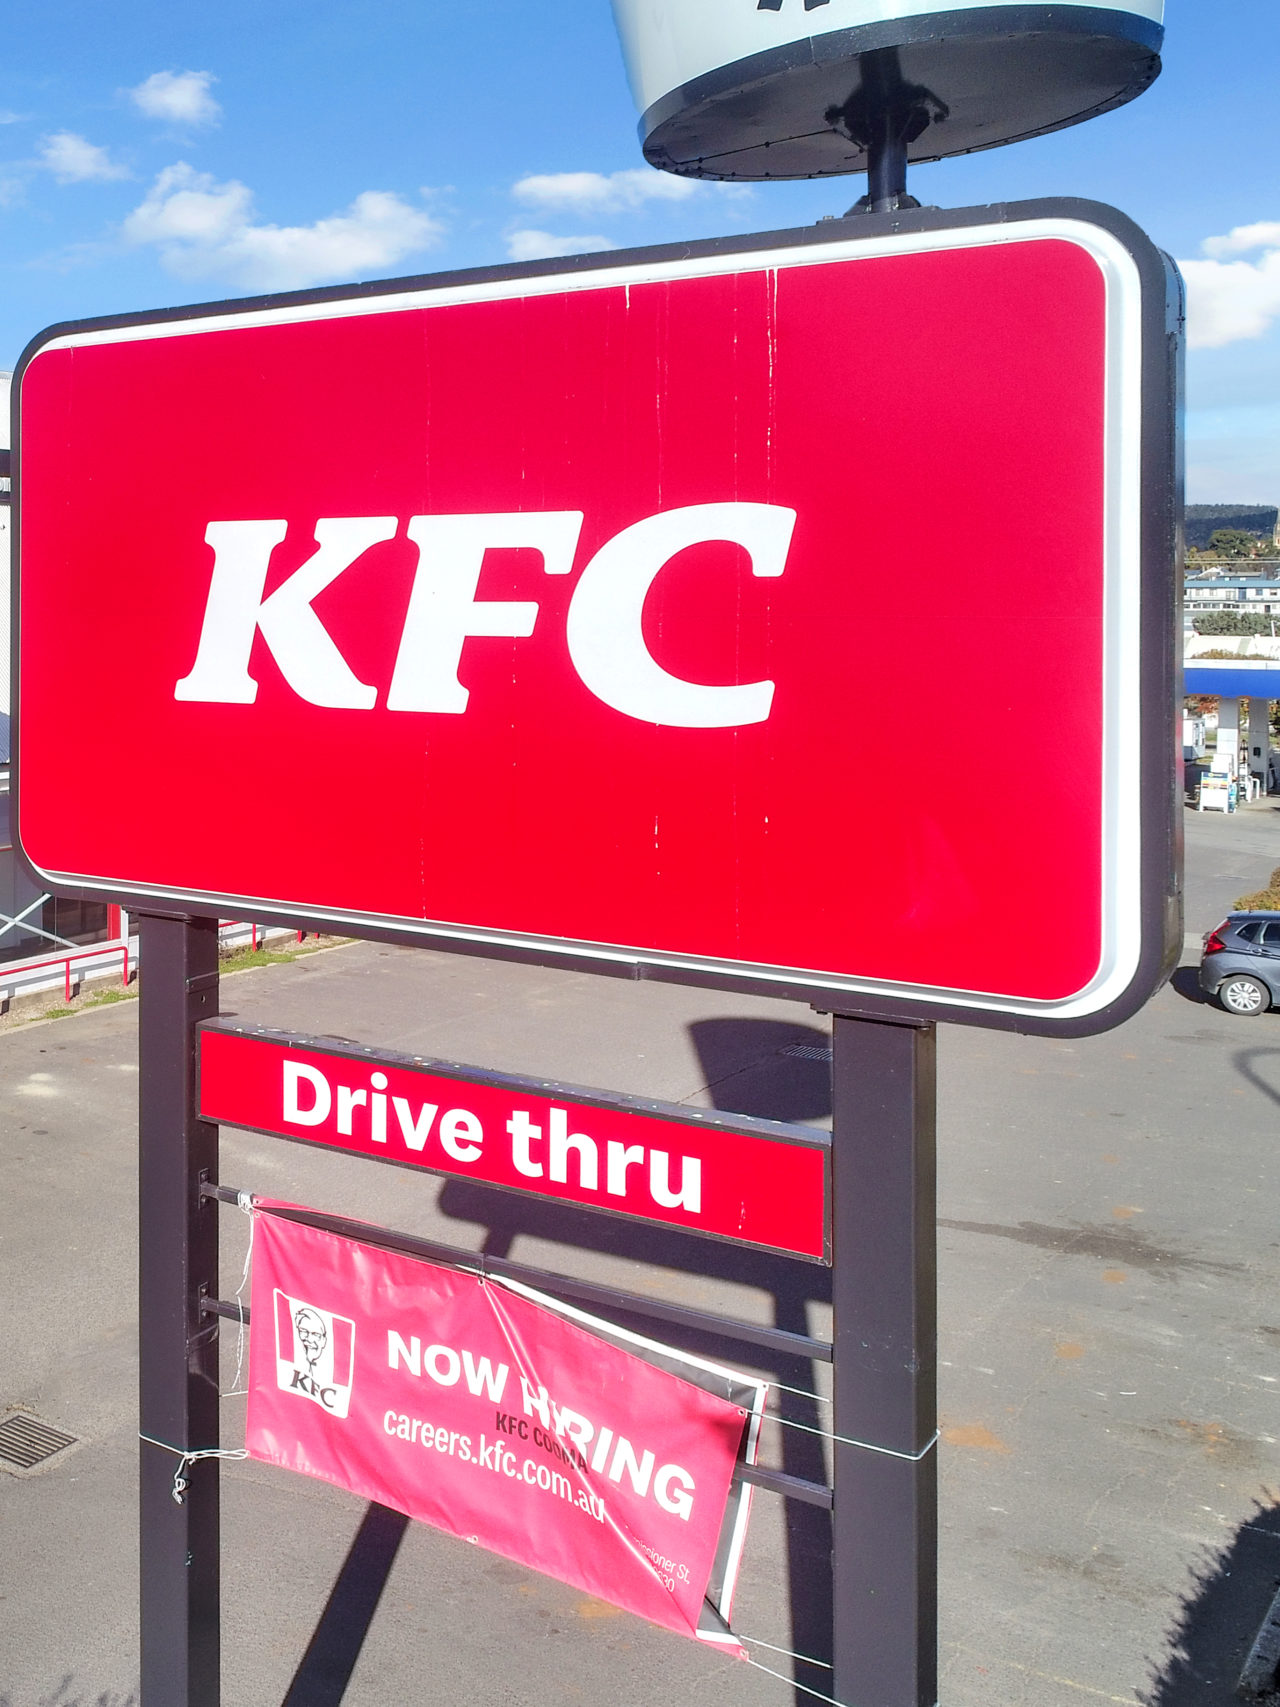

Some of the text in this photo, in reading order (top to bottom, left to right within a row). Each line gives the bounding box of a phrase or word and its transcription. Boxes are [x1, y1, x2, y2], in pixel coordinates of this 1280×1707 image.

[173, 501, 797, 729] KFC
[282, 1059, 702, 1214] Drive thru
[289, 1369, 337, 1409] KFC
[387, 1329, 510, 1404] NOW
[383, 1409, 605, 1524] careers.kfc.com.au
[495, 1411, 589, 1474] KFC COOMA
